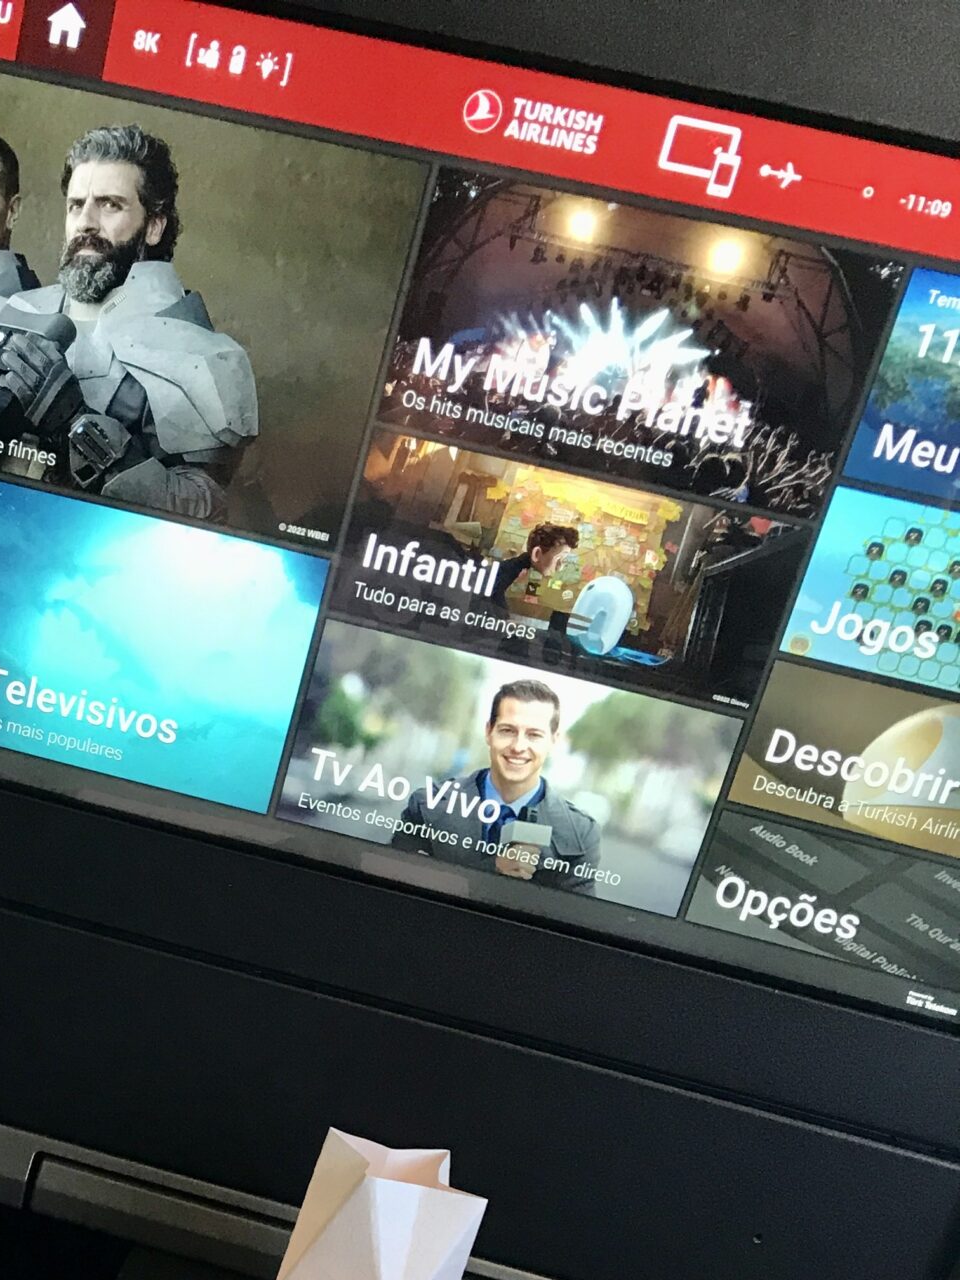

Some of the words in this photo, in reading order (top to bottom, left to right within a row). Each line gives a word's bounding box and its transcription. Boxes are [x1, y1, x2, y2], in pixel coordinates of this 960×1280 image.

[133, 29, 161, 54] 8K
[504, 119, 598, 155] AIRLINES
[514, 97, 604, 134] TURKISH
[900, 194, 952, 218] -11:09
[412, 337, 477, 393] My
[483, 353, 608, 415] Music
[616, 379, 752, 448] Planet
[8, 438, 57, 467] filmes
[402, 390, 425, 411] Os
[429, 394, 463, 420] hits
[465, 406, 545, 439] musicais
[548, 425, 593, 449] mais
[596, 436, 674, 468] recentes
[872, 424, 960, 474] Meu
[286, 524, 307, 536] 2022
[362, 532, 501, 598] Infantil
[354, 580, 395, 606] Tudo
[397, 594, 436, 617] para
[439, 605, 461, 622] as
[464, 611, 537, 640] crianças
[810, 601, 940, 659] Jogos
[6, 720, 44, 741] mais
[47, 731, 123, 761] populares
[311, 747, 353, 787] Tv
[357, 763, 411, 801] Ao
[425, 775, 501, 824] Vivo
[764, 728, 960, 804] Descobrir
[752, 774, 835, 810] Descubra
[838, 800, 849, 813] a
[855, 801, 918, 829] Turkish
[297, 792, 362, 821] Eventos
[365, 809, 459, 846] desportivos
[461, 836, 473, 849] e
[475, 839, 540, 866] notícias
[543, 856, 570, 874] em
[573, 862, 622, 886] direto
[749, 825, 786, 848] Audio
[785, 844, 818, 866] Book
[715, 876, 860, 939] Opções
[906, 913, 930, 932] The
[834, 937, 878, 960] Digital
